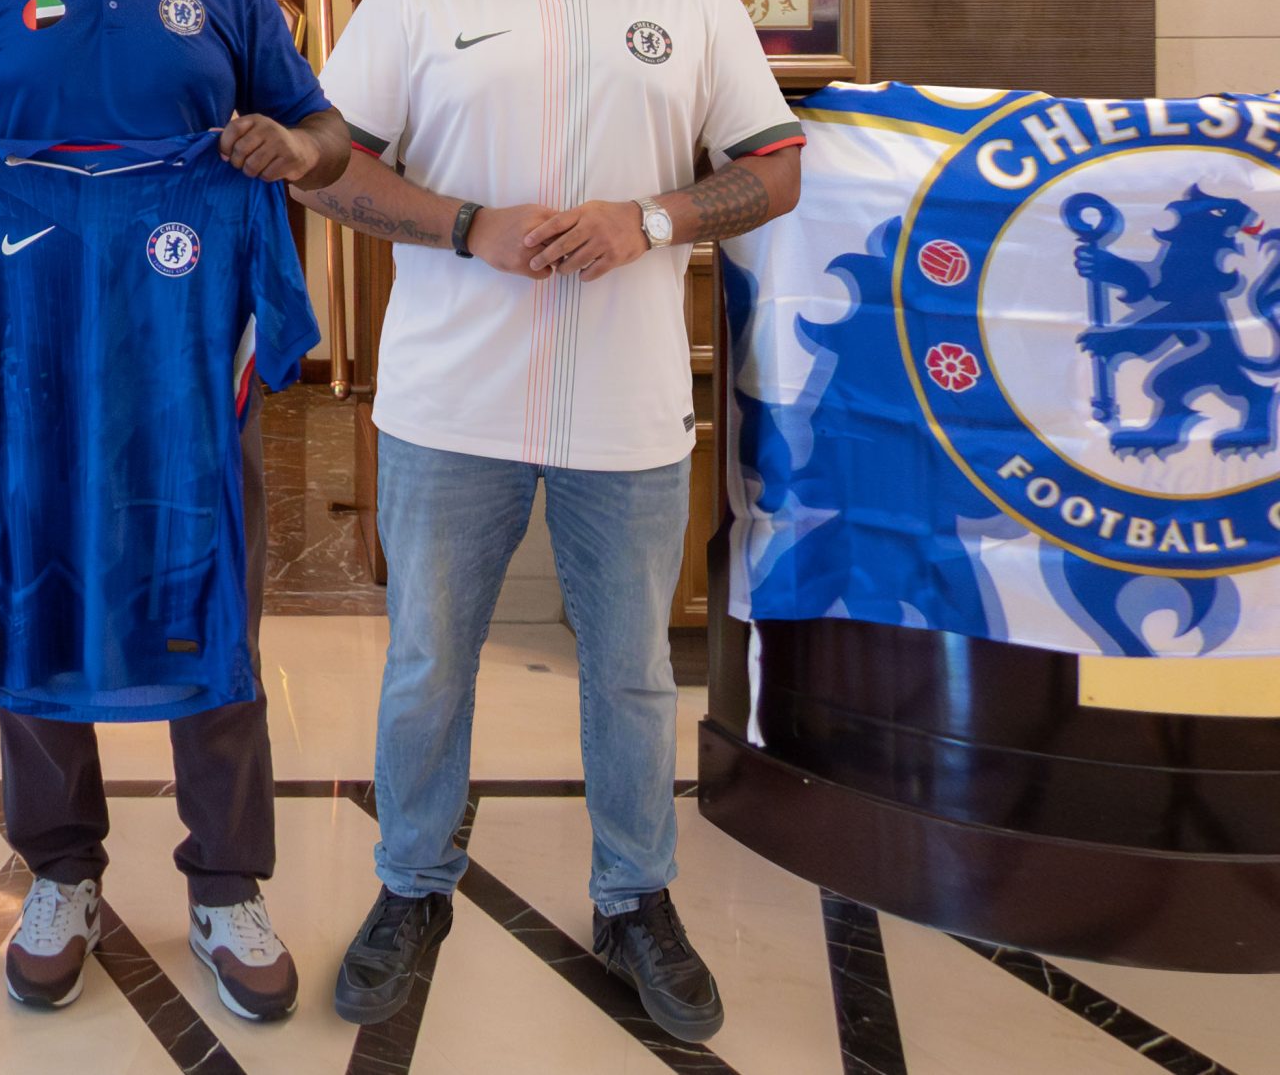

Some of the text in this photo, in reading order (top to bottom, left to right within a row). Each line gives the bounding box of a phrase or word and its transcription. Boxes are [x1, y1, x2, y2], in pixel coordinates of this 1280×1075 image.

[976, 96, 1280, 190] CHELSE
[160, 225, 194, 239] CHELSEA
[997, 455, 1247, 553] FOOTBALL
